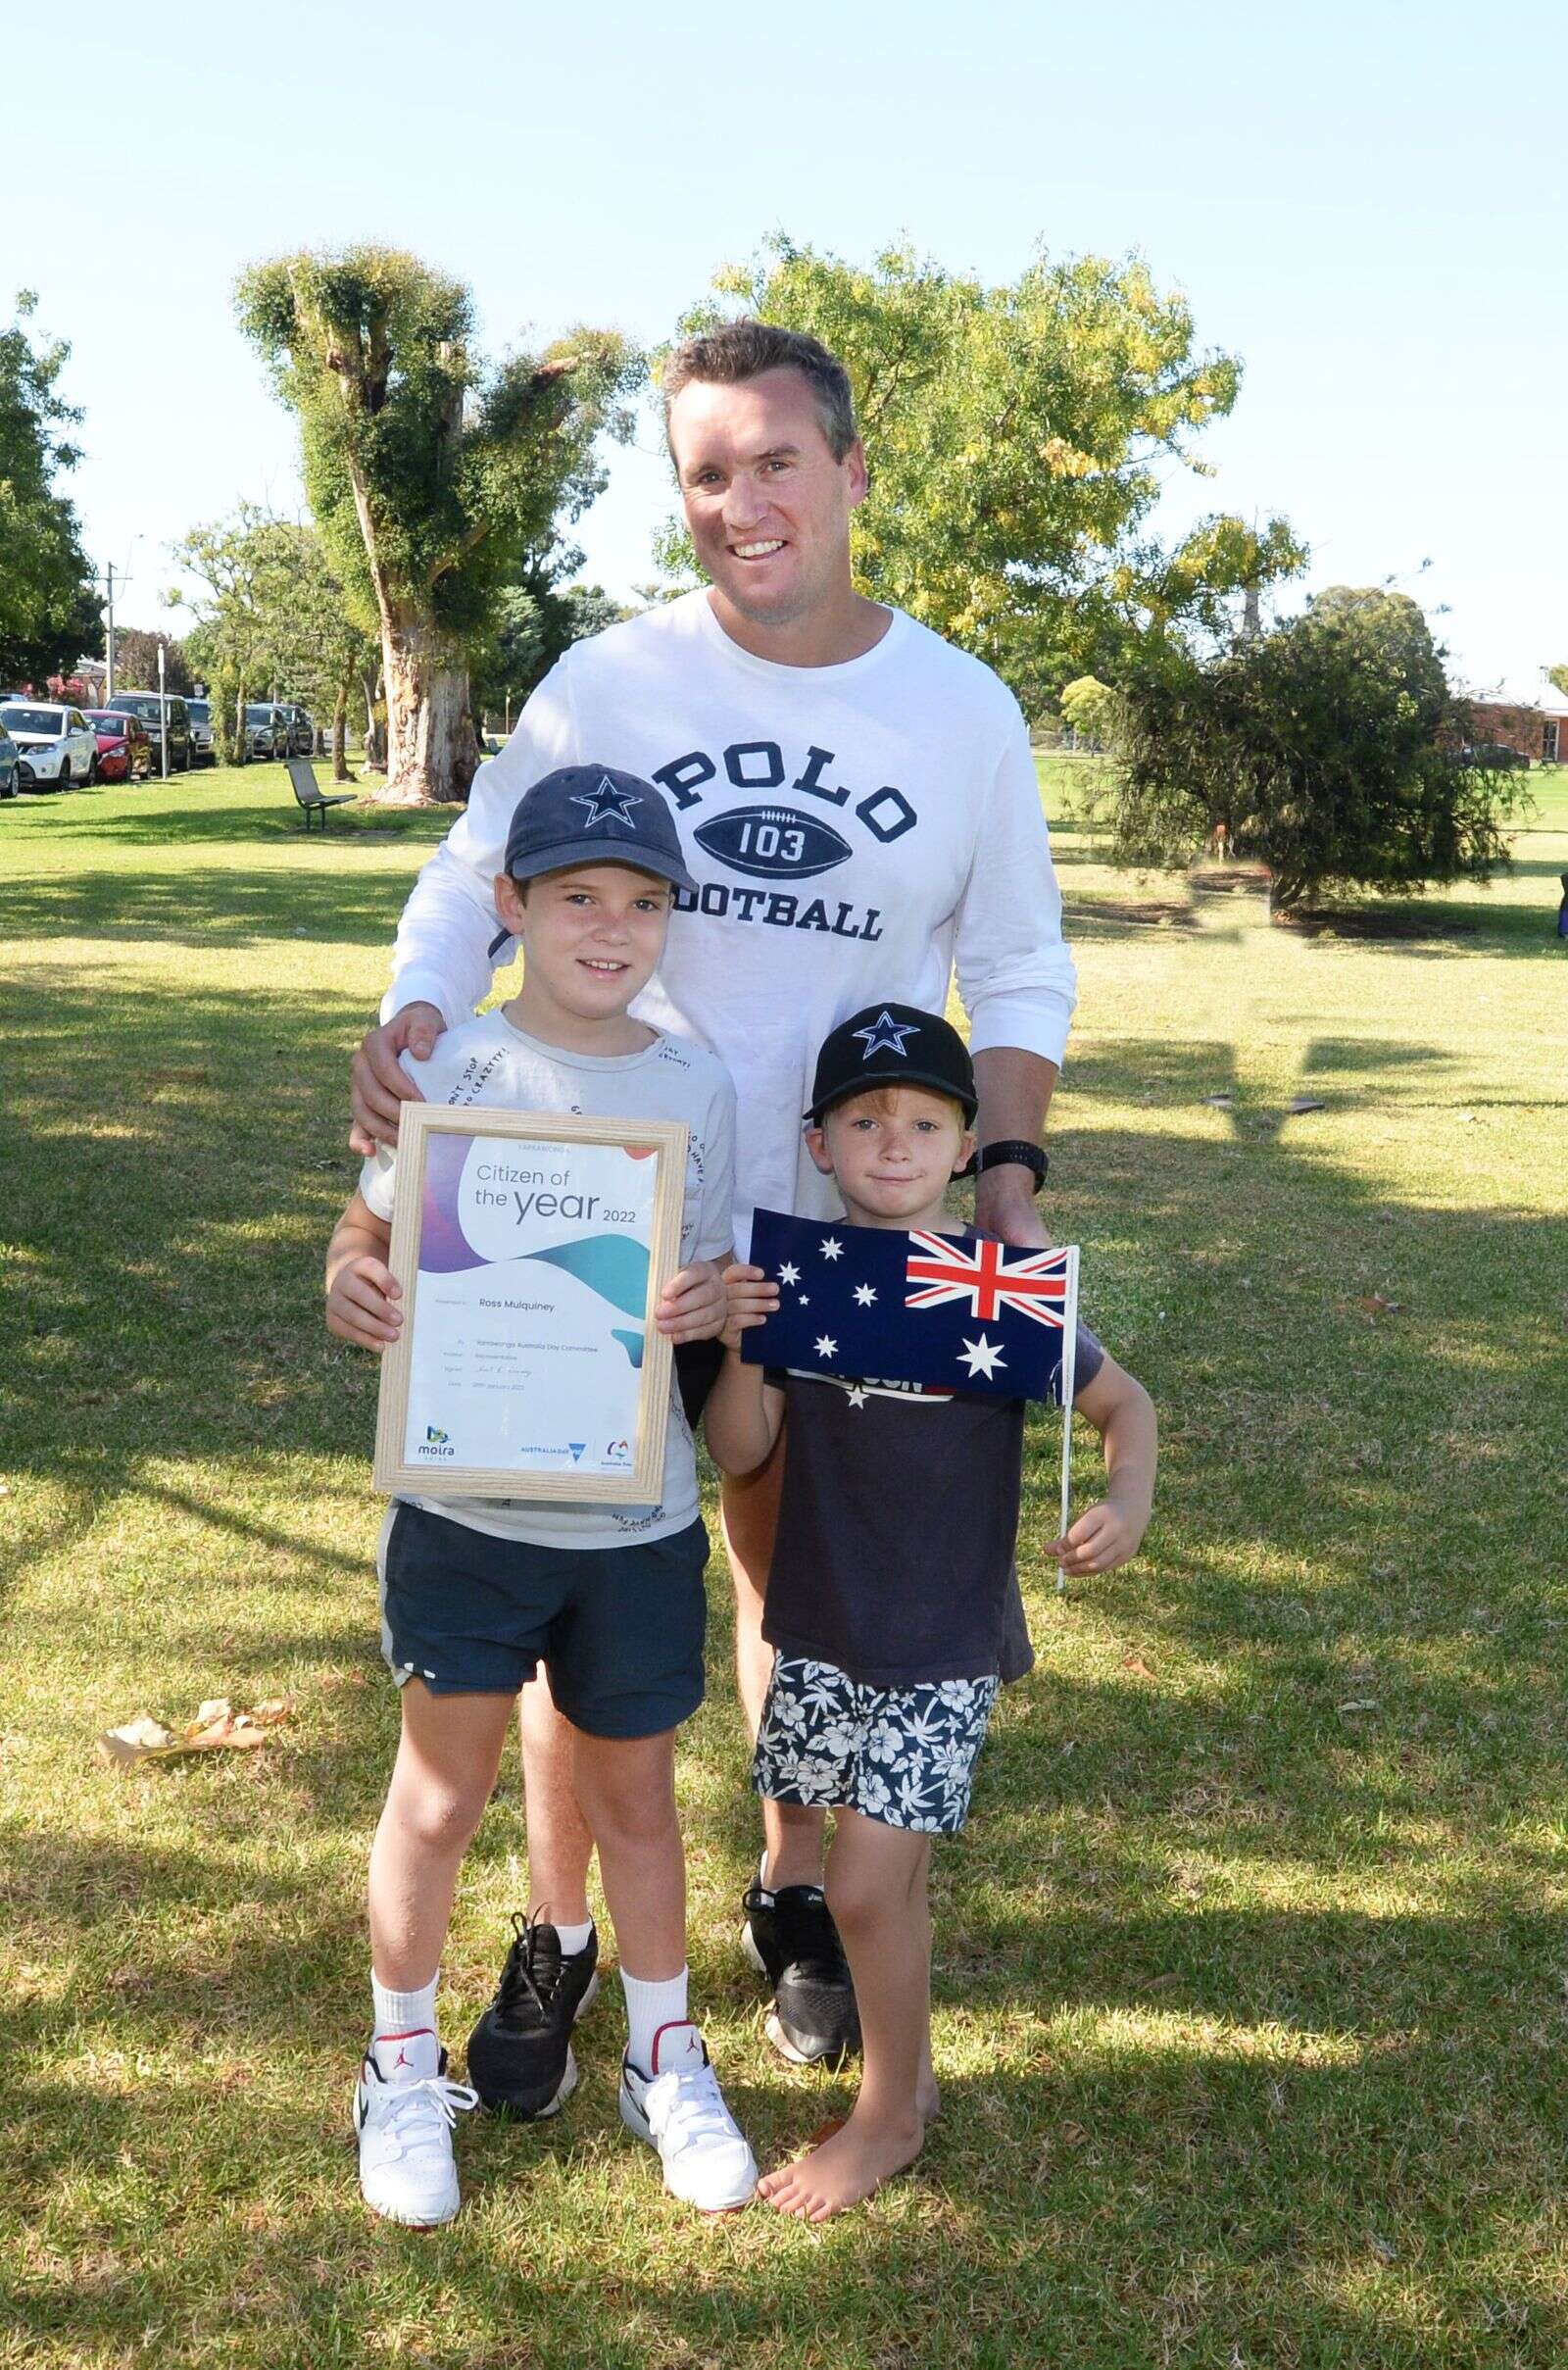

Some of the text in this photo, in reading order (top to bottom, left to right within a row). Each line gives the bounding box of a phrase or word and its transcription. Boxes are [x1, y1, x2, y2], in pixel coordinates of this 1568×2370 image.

[651, 741, 918, 843] POLO
[739, 822, 806, 862] 103
[672, 882, 883, 942] OOTBALL
[463, 1057, 478, 1081] STOP
[476, 1164, 570, 1186] Citizen of
[475, 1189, 636, 1225] the year 2022
[479, 1298, 502, 1308] Ross
[505, 1300, 556, 1313] Mulquiney
[417, 1445, 455, 1457] moira
